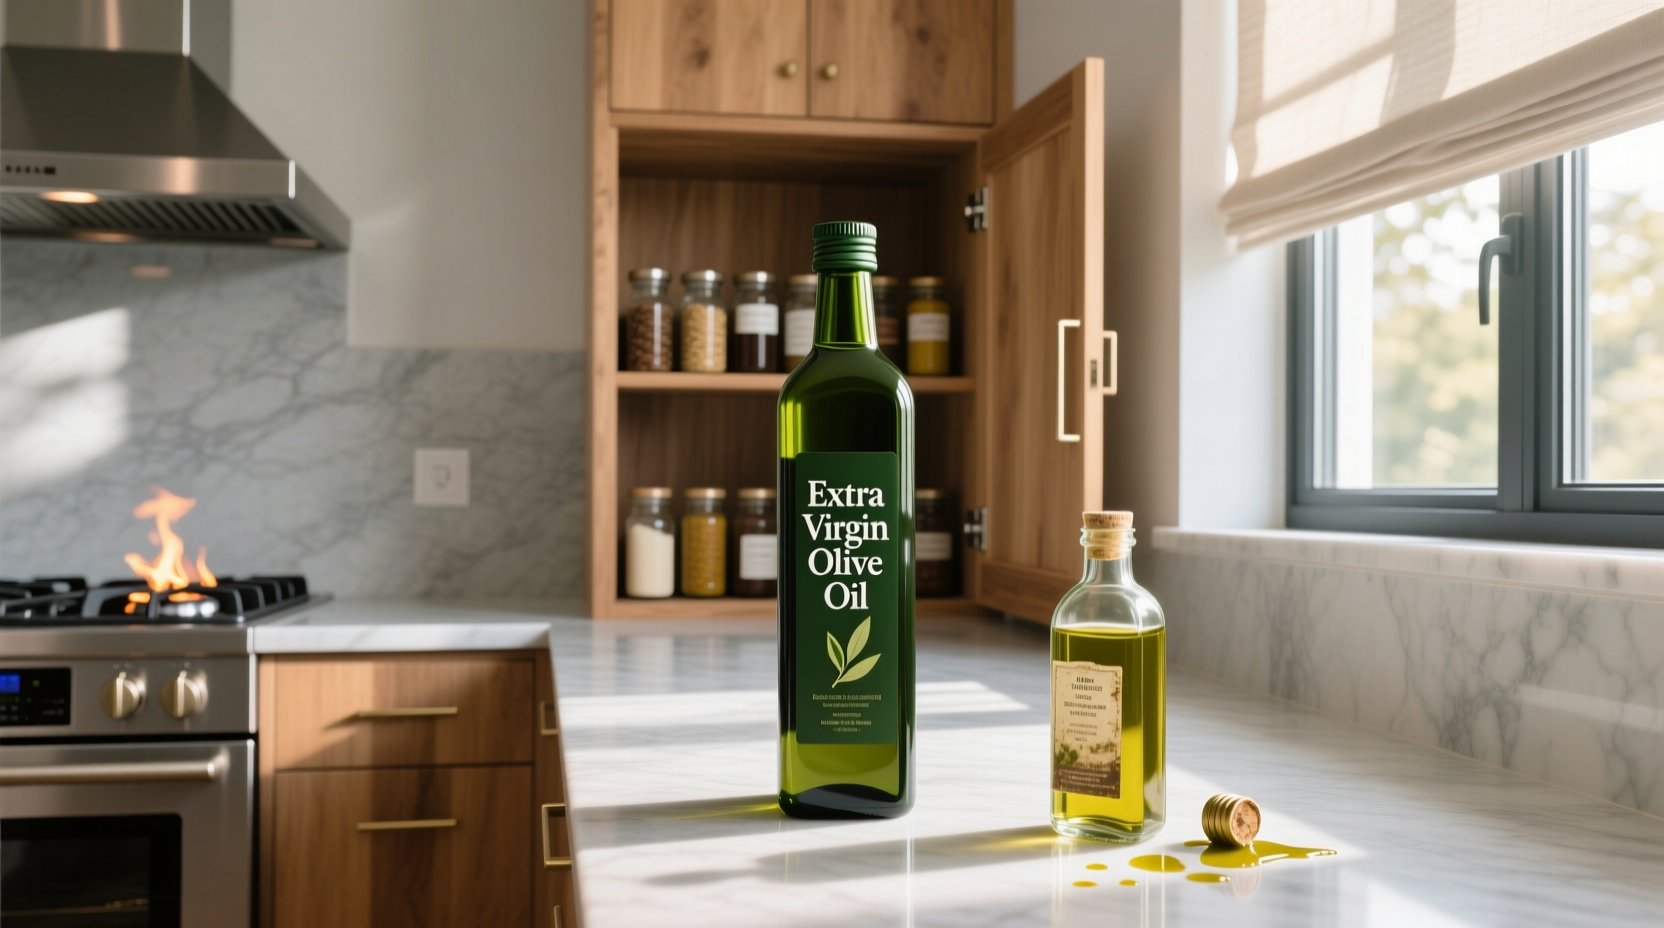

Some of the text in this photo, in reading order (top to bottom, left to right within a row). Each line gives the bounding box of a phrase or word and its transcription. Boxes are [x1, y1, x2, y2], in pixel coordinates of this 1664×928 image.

[807, 480, 885, 507] Extra
[802, 514, 889, 549] Virgin
[808, 548, 883, 575] Olive
[824, 581, 869, 609] Oil
